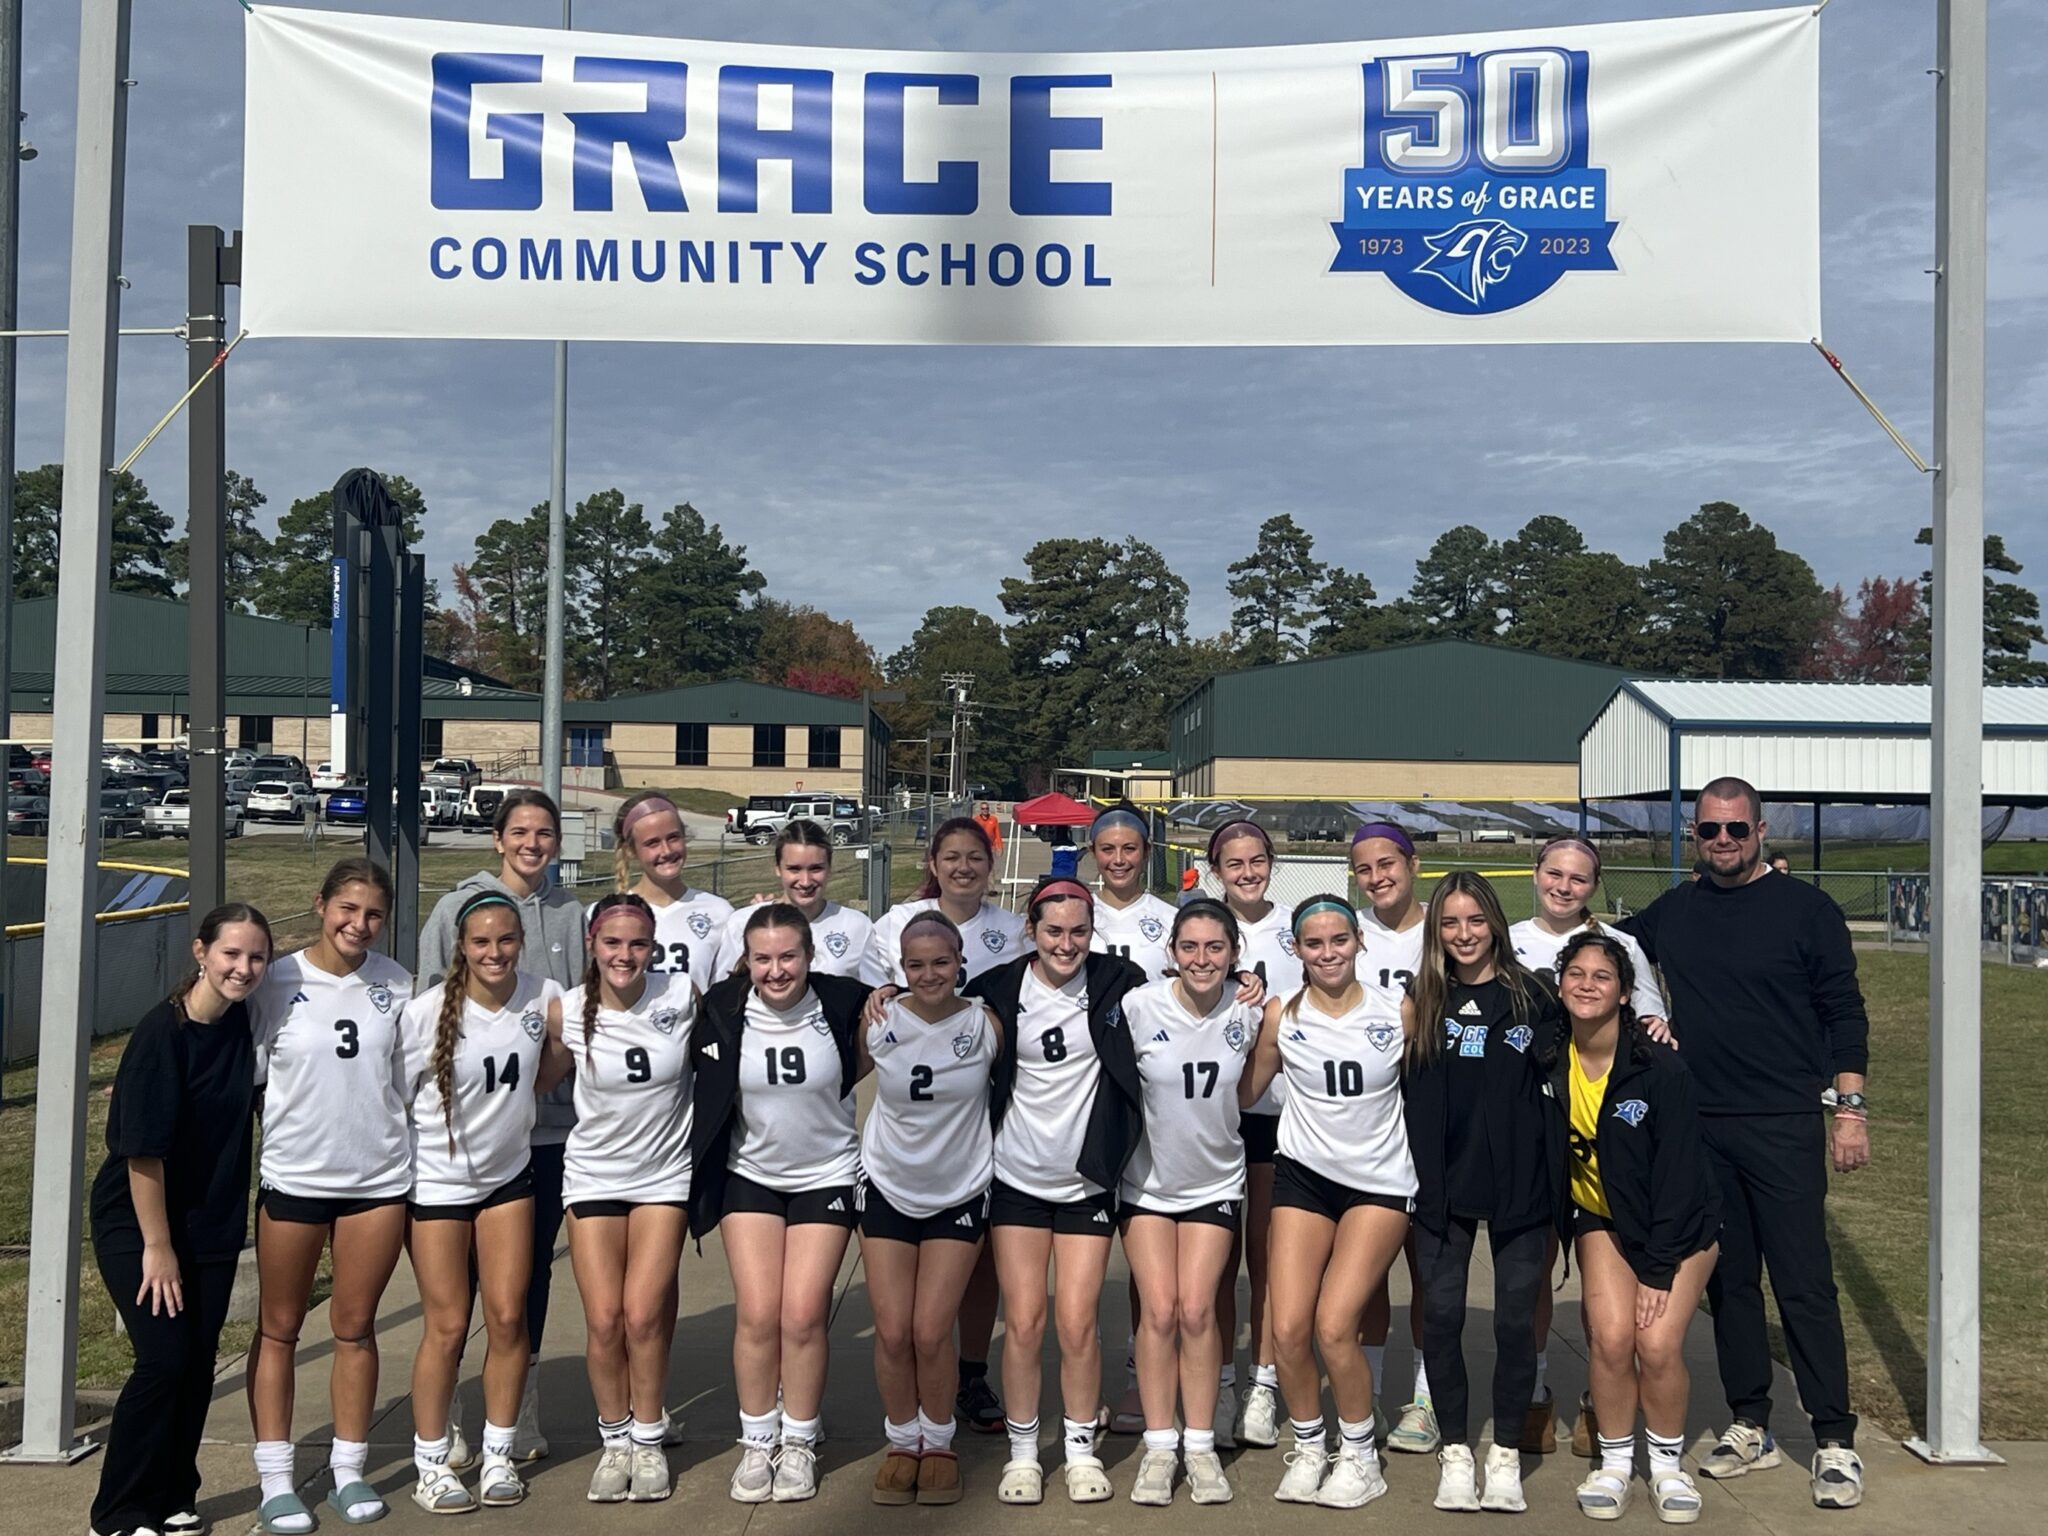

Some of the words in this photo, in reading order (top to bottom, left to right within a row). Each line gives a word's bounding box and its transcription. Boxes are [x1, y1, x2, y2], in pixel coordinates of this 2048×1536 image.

[1379, 48, 1574, 174] 50
[430, 52, 1112, 216] GRACE
[1356, 186, 1454, 209] YEARS
[1461, 181, 1493, 215] of
[1499, 186, 1595, 209] GRACE
[429, 236, 827, 285] COMMUNITY
[854, 242, 1112, 287] SCHOOL
[1359, 239, 1404, 255] 1973
[1540, 238, 1590, 255] 2023
[647, 942, 690, 973] 23
[334, 1019, 359, 1059] 3
[1041, 1026, 1067, 1063] 8
[483, 1052, 520, 1094] 14
[625, 1046, 651, 1083] 9
[765, 1046, 806, 1085] 19
[910, 1064, 934, 1101] 2
[1182, 1061, 1219, 1099] 17
[1323, 1060, 1363, 1097] 10
